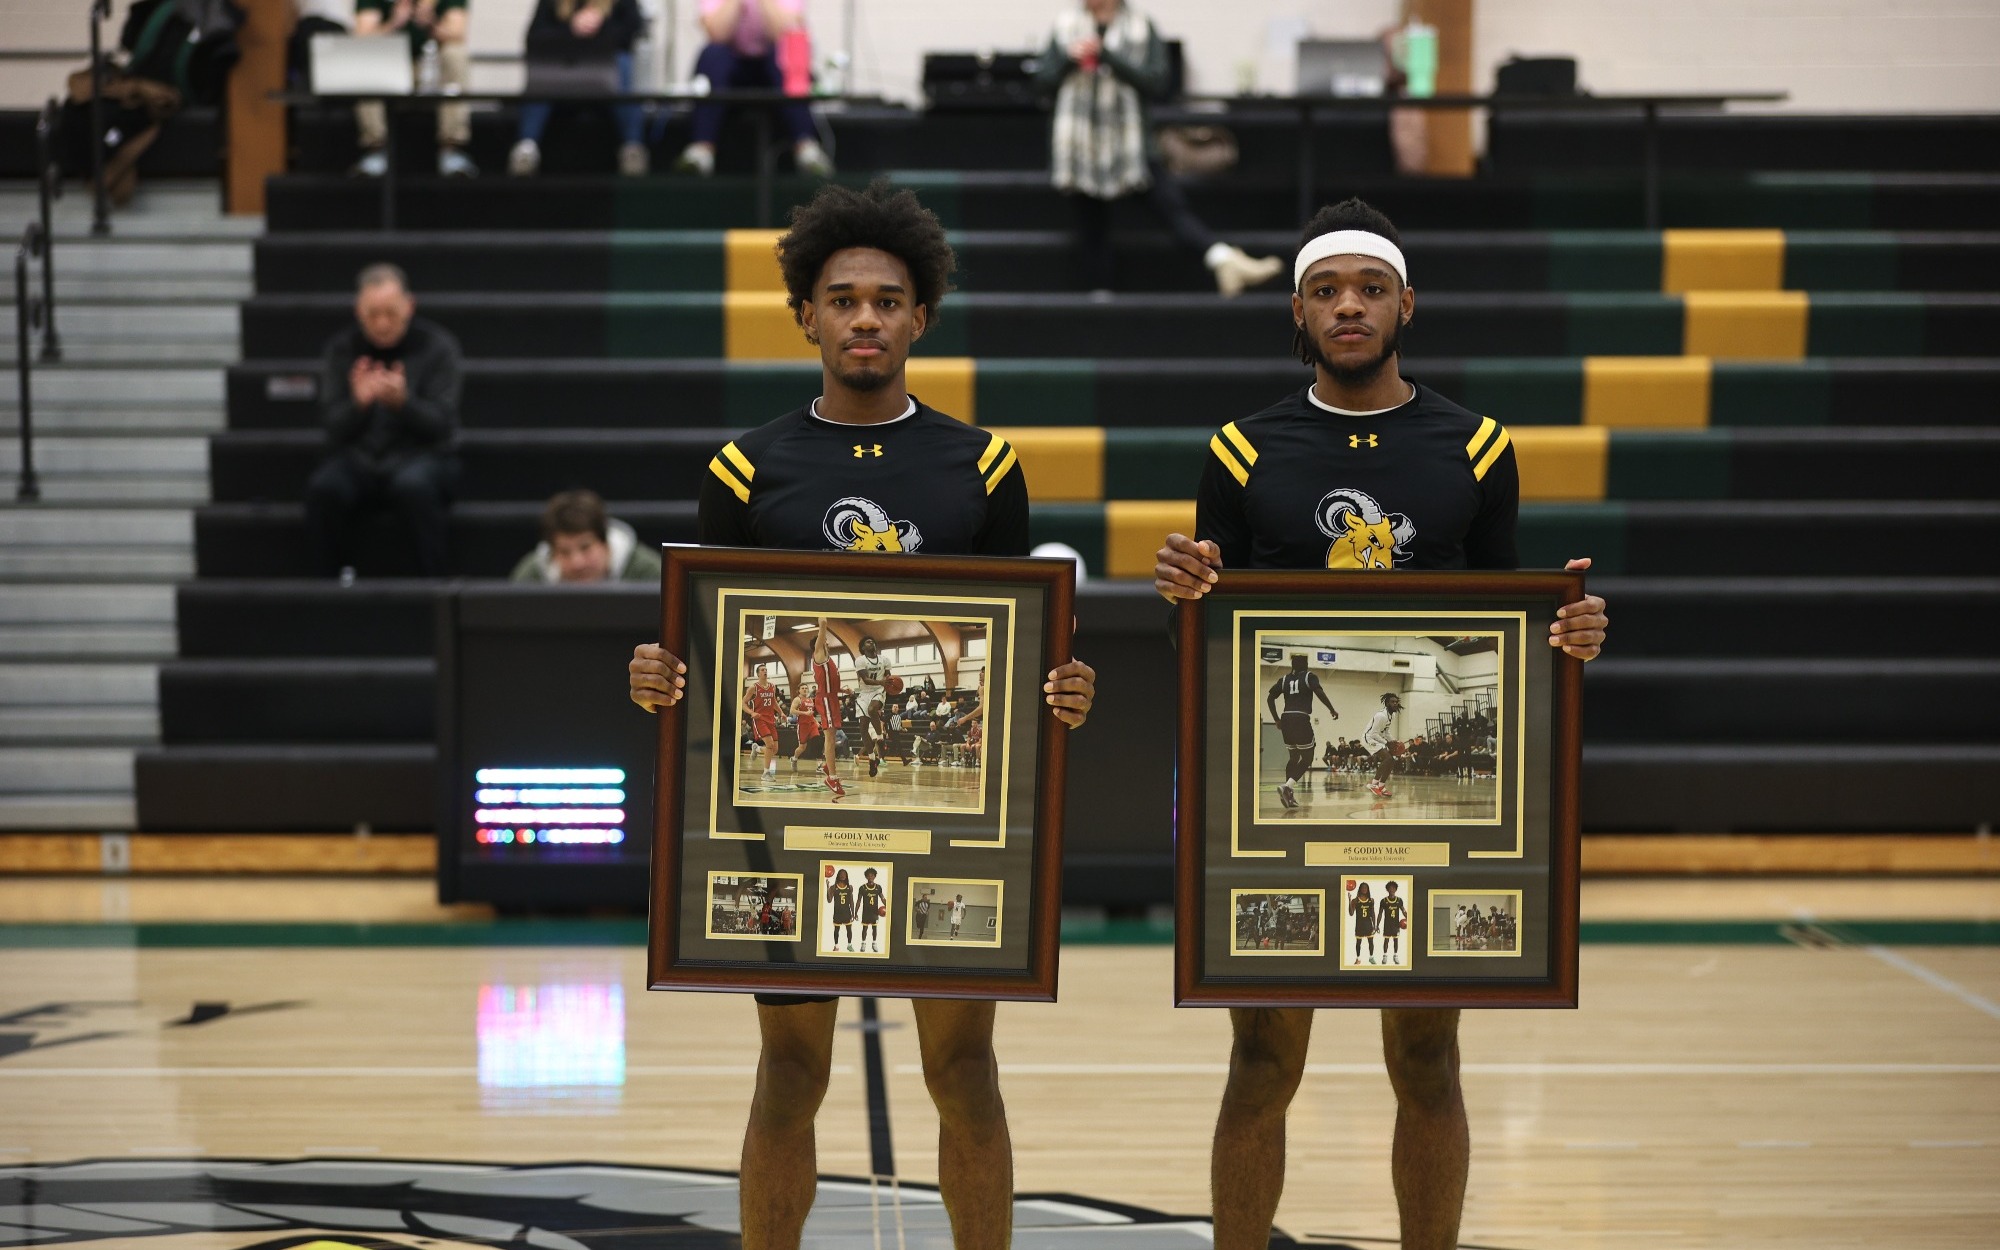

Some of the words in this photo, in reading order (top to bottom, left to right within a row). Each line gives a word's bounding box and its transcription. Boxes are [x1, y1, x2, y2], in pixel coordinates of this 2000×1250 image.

[763, 698, 771, 706] 23
[834, 832, 864, 840] GODLY
[864, 833, 890, 841] MARC
